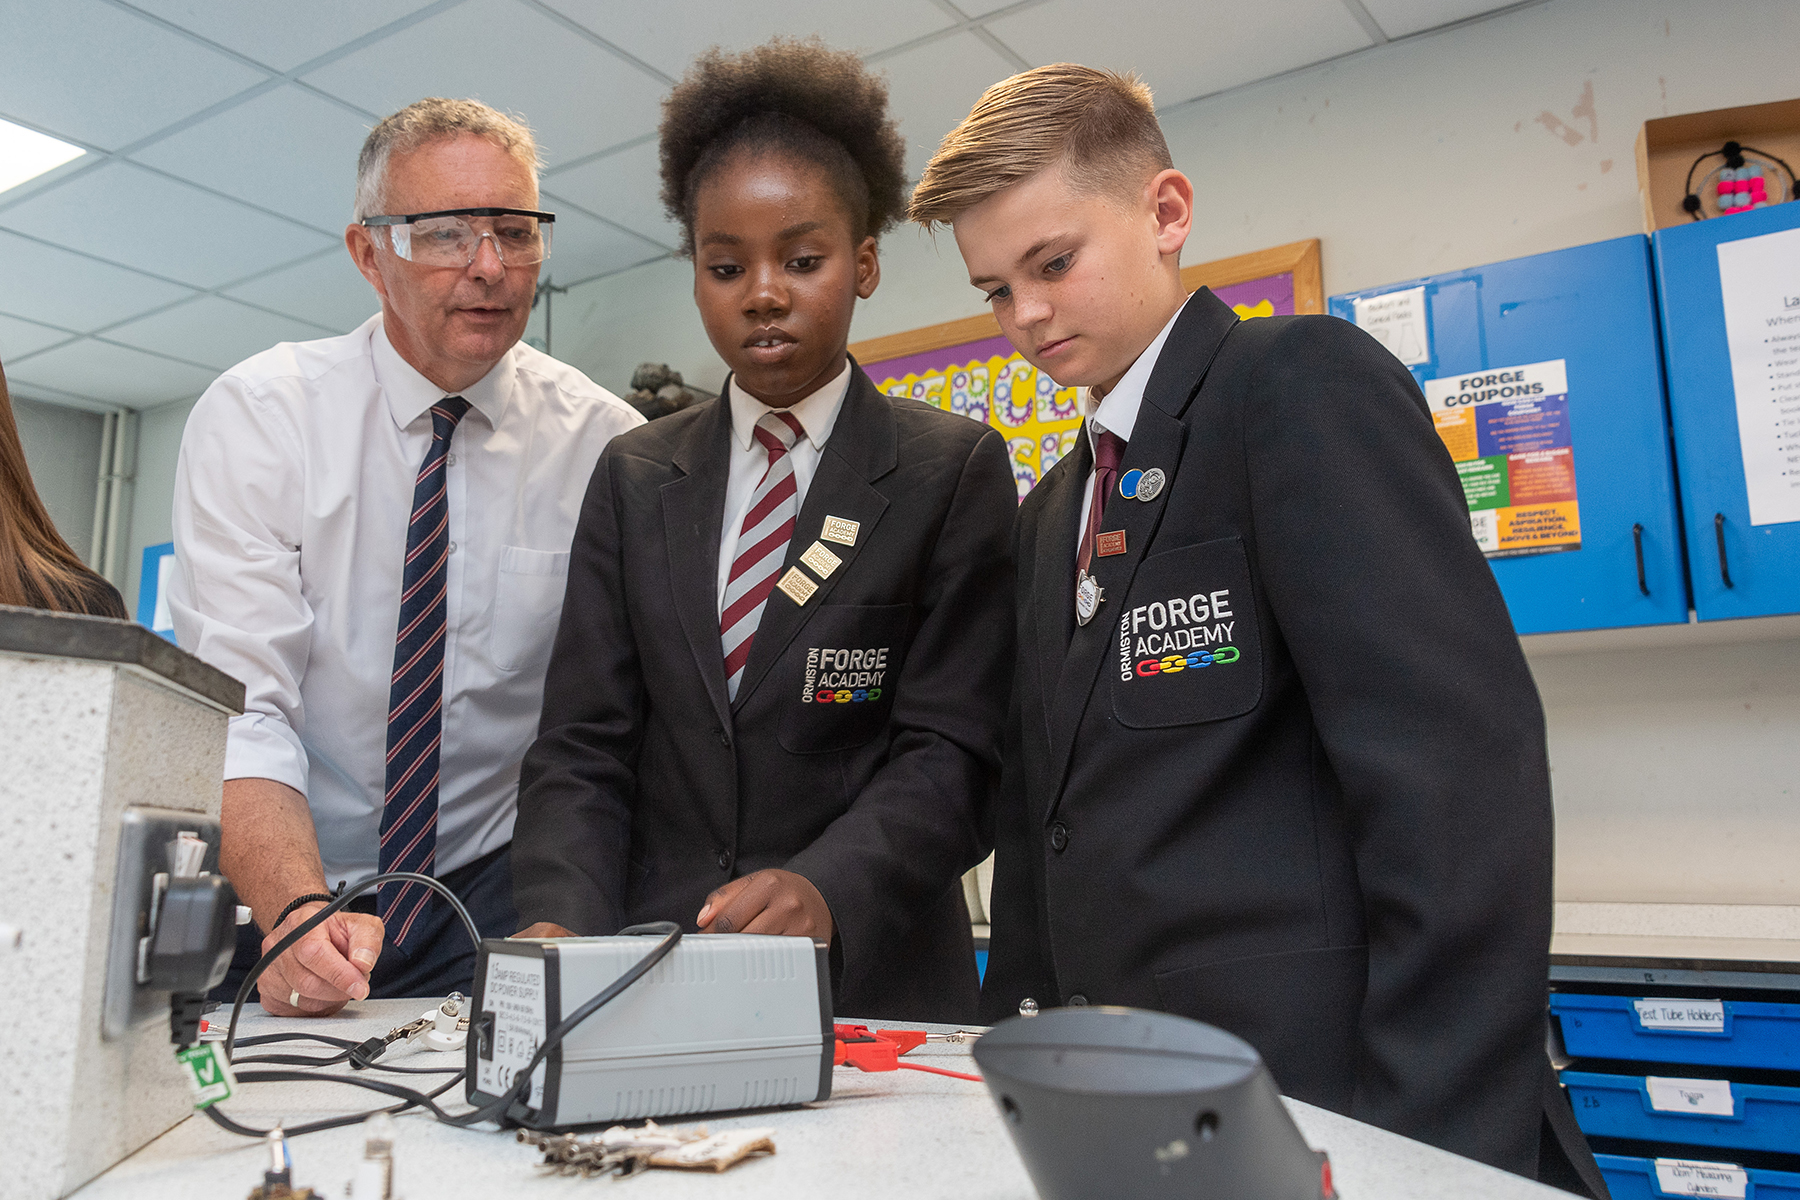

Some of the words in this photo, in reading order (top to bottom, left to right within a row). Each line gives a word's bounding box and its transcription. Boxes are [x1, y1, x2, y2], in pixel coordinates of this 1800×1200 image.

[1460, 370, 1525, 391] FORGE
[1445, 382, 1545, 407] COUPONS
[829, 527, 855, 537] ACADEMY
[831, 520, 857, 532] FORGE
[1500, 535, 1531, 543] ABOVE
[815, 547, 838, 567] FORGE
[788, 579, 809, 598] ACADEMY
[791, 573, 815, 593] FORGE
[1132, 589, 1233, 634] FORGE
[1121, 611, 1133, 682] ORMISTON
[1135, 621, 1235, 657] ACADEMY
[820, 647, 890, 671] FORGE
[801, 647, 819, 704] ORMISTON
[818, 671, 886, 688] ACADEMY
[509, 970, 542, 986] REGULATED
[498, 982, 518, 997] POWER
[519, 986, 539, 1001] SUPPLY
[1637, 1007, 1657, 1020] Test
[1660, 1007, 1684, 1021] Tube
[1686, 1009, 1723, 1022] Holders
